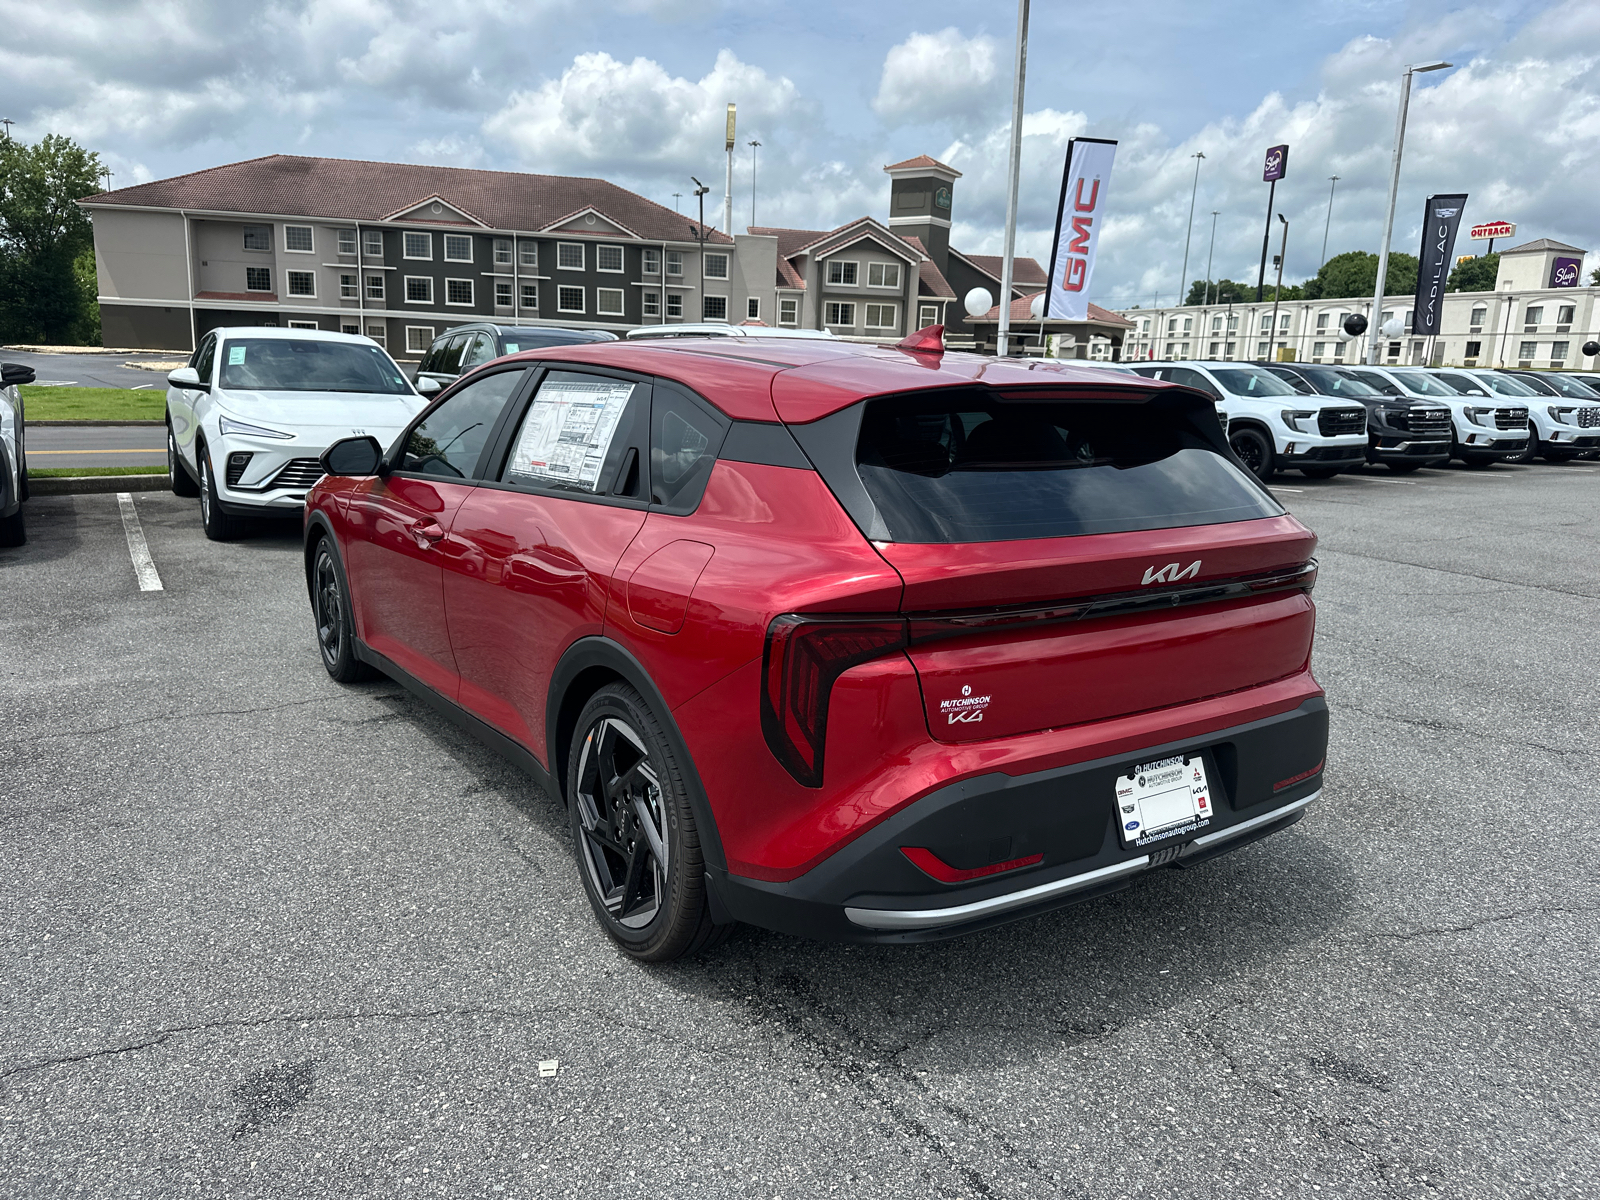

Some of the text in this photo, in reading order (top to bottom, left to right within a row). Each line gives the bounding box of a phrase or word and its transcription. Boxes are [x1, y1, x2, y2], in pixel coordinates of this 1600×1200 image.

[1062, 178, 1100, 292] GMC
[1471, 226, 1511, 237] OUTBACK
[1426, 225, 1448, 326] CADILLAC
[1555, 268, 1575, 283] Sleep
[1141, 560, 1202, 585] KIA
[940, 696, 991, 708] HUTCHINSON
[1143, 755, 1184, 772] HUTCHINSON
[1136, 819, 1209, 847] Hutchinsonautogroup.com
